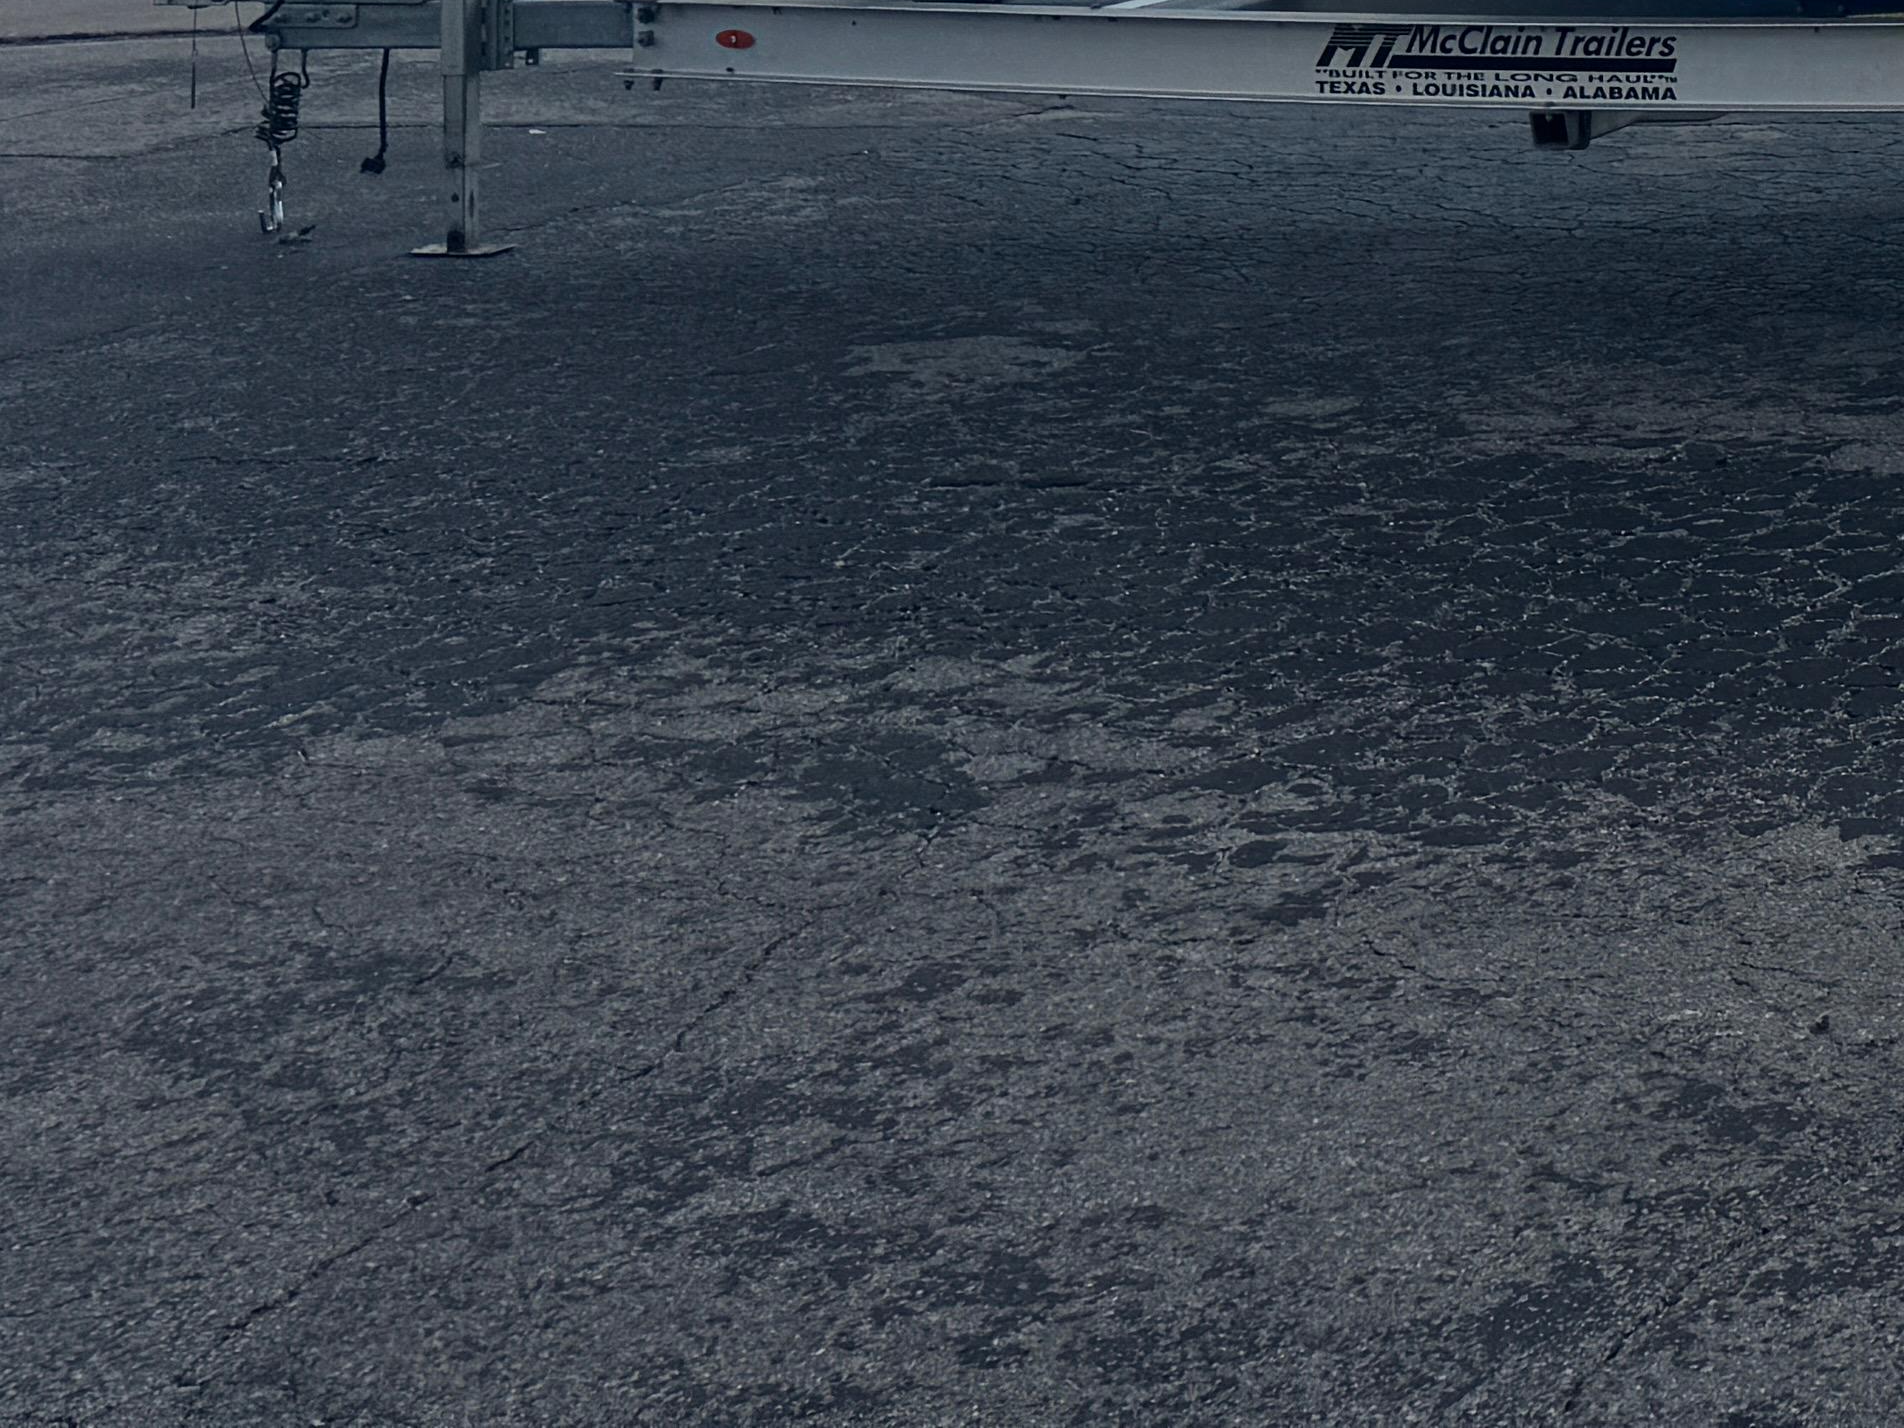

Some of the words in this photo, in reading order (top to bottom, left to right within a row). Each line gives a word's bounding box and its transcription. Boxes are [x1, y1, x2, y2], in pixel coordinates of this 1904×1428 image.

[1406, 24, 1543, 56] McClain
[1554, 26, 1678, 58] Trailers
[1393, 70, 1437, 81] FOR
[1444, 72, 1485, 82] THE
[1494, 72, 1578, 83] LONG
[1316, 81, 1386, 95] TEXAS
[1412, 82, 1536, 99] LOUISIANA
[1562, 85, 1677, 101] ALABAMA
